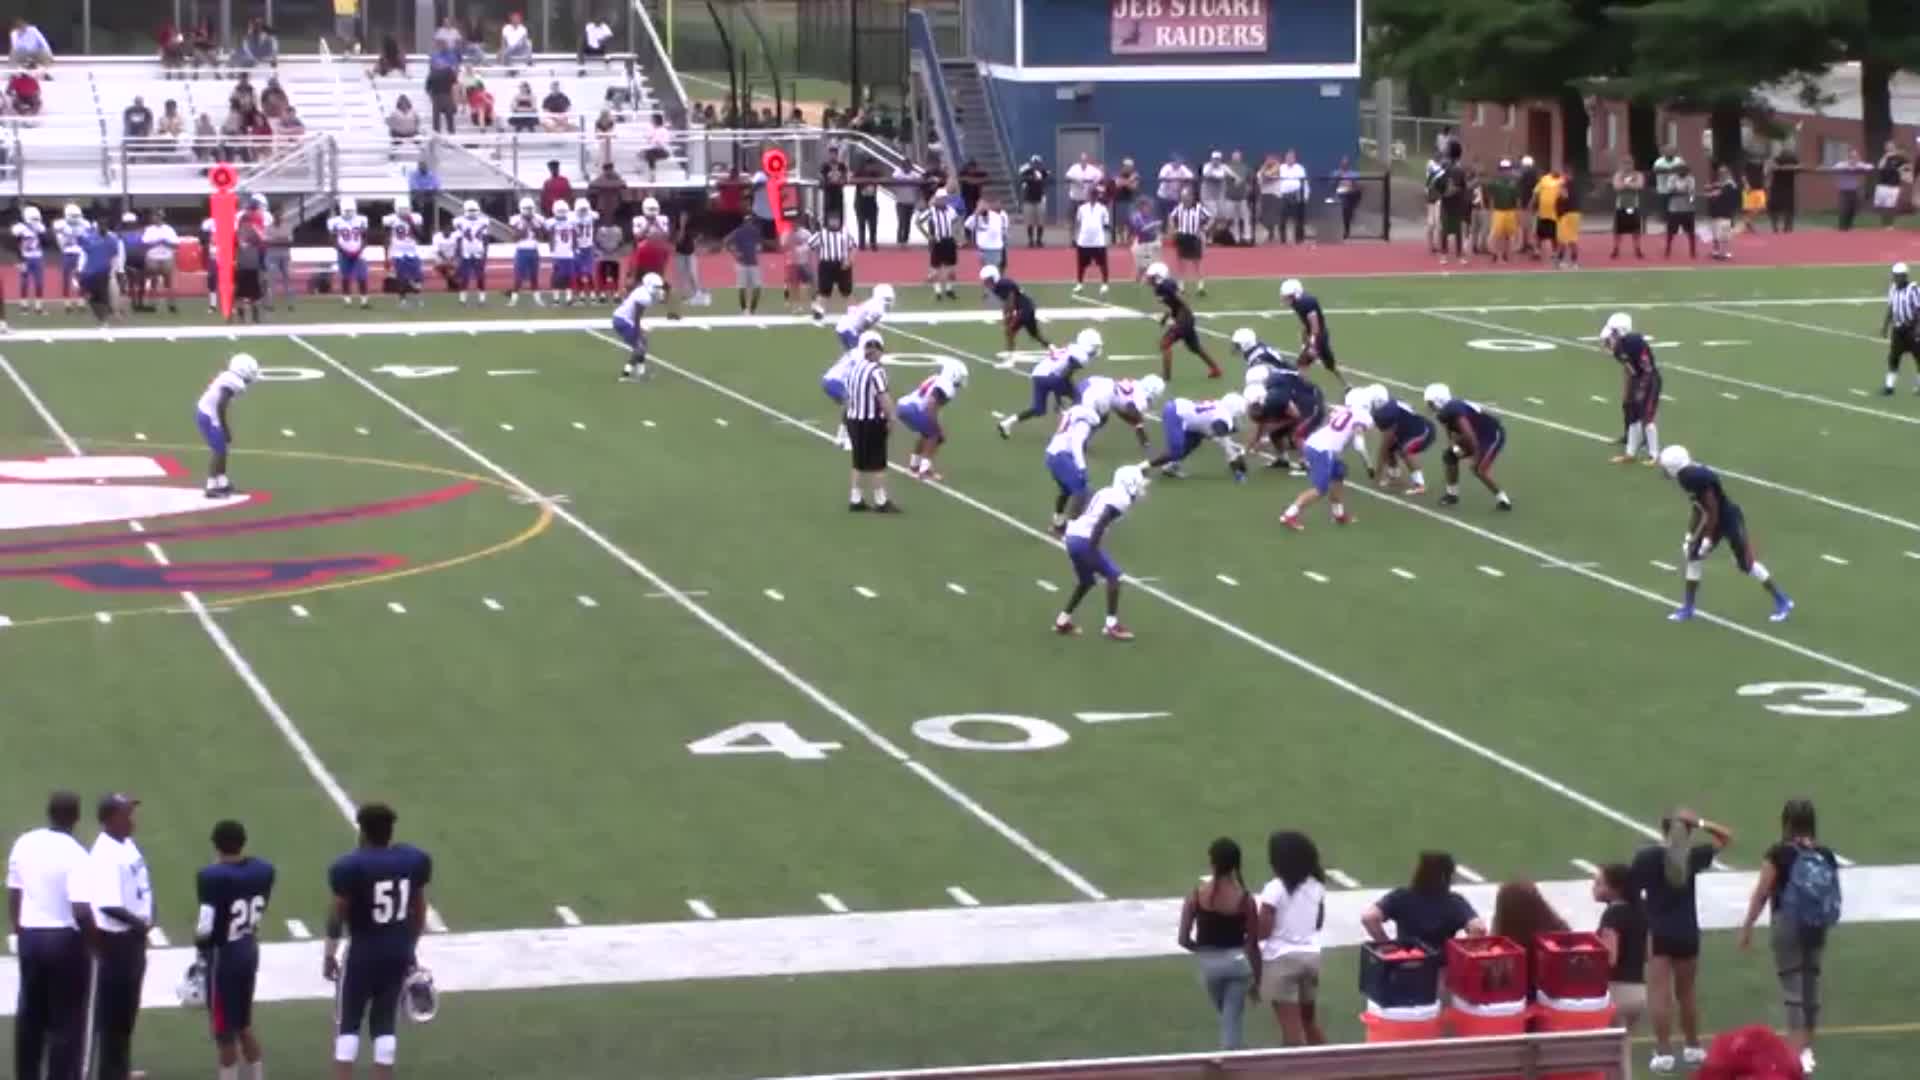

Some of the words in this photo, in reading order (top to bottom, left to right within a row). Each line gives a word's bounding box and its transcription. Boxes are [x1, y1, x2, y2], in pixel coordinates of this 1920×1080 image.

[1113, 0, 1163, 18] JEB
[1169, 0, 1262, 18] STUART
[1156, 25, 1265, 47] RAIDERS
[1736, 681, 1911, 717] 3
[686, 713, 1071, 760] 40
[227, 895, 266, 941] 26
[372, 878, 411, 923] 51
